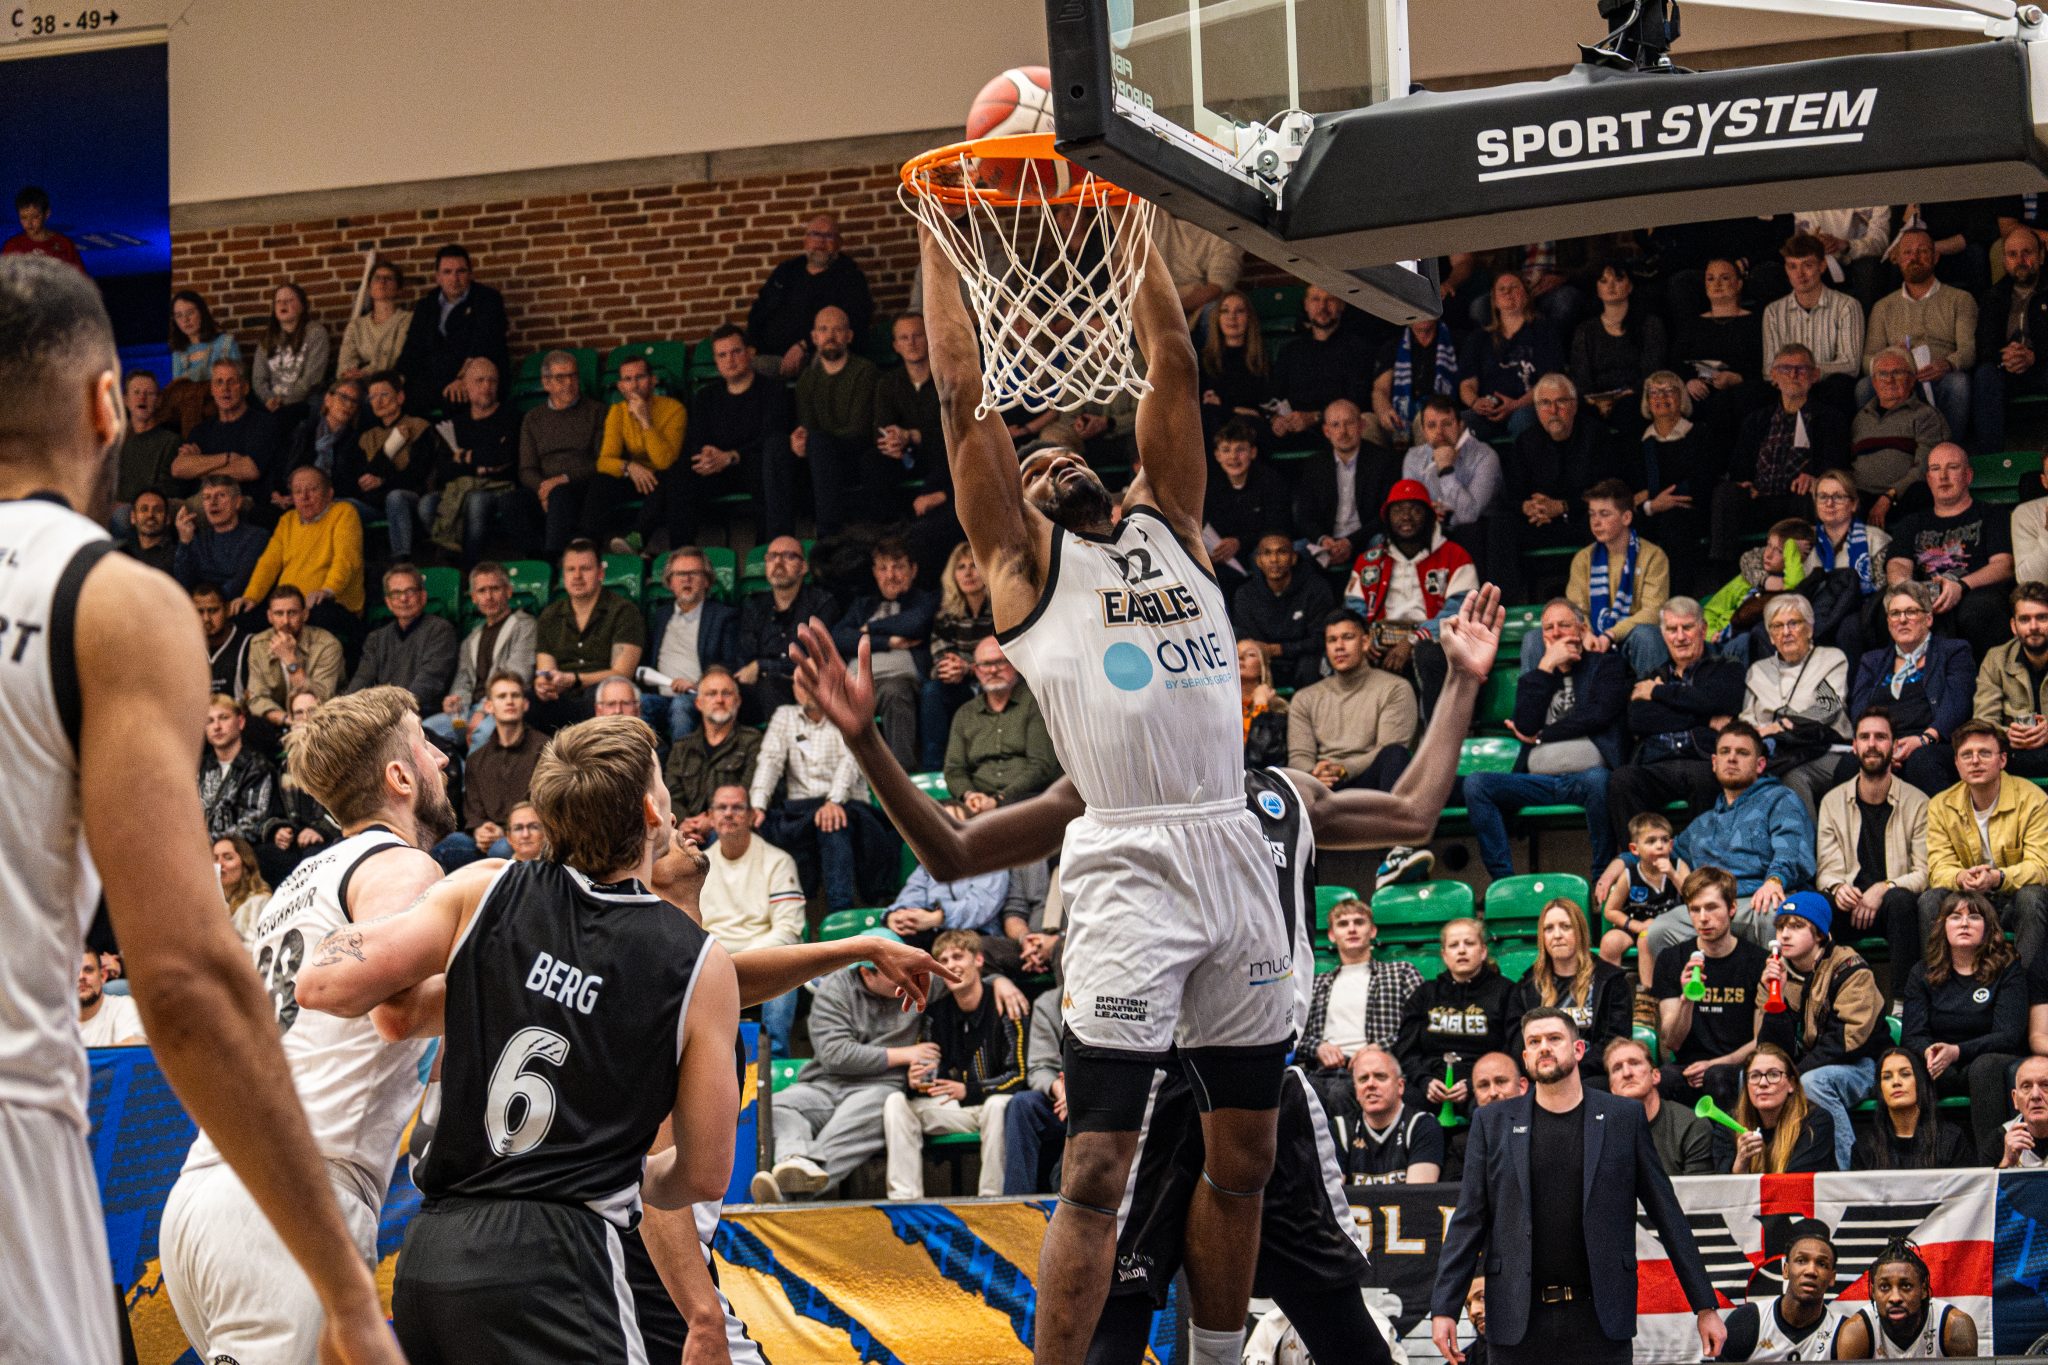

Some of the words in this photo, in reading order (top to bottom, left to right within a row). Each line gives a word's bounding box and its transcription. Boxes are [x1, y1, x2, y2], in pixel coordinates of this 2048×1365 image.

[11, 8, 24, 28] C
[32, 14, 56, 35] 38
[76, 10, 101, 30] 49
[1476, 110, 1652, 167] SPORT
[1657, 88, 1878, 156] SYSTEM
[1157, 633, 1228, 673] ONE
[525, 951, 603, 1015] BERG
[1095, 1003, 1146, 1014] BASKETBALL
[1096, 995, 1148, 1007] BRITISH
[1095, 1010, 1147, 1022] LEAGUE
[1428, 1012, 1488, 1034] EAGLES
[484, 1026, 571, 1157] 6
